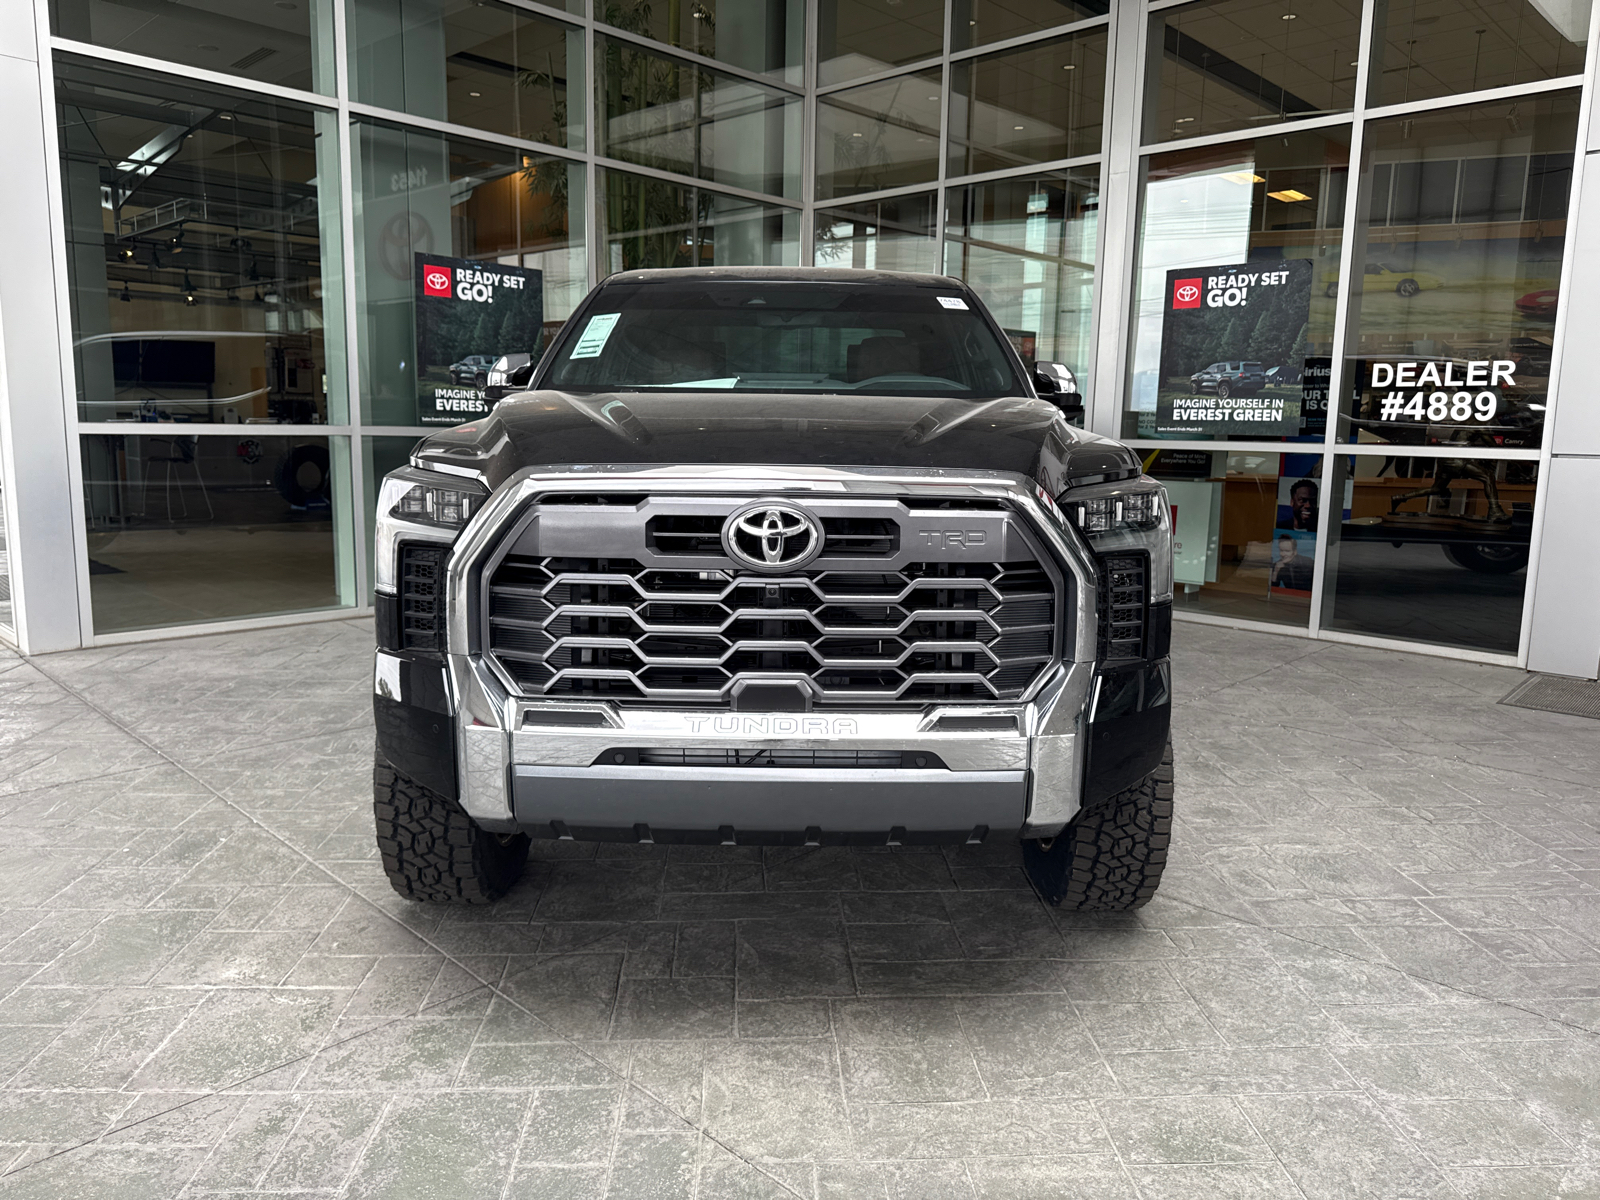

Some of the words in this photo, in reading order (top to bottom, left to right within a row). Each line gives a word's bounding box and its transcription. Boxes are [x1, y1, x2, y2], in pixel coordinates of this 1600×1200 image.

[456, 268, 501, 286] READY
[502, 275, 525, 289] SET
[1207, 273, 1258, 289] READY
[1261, 271, 1290, 286] SET
[456, 282, 493, 304] GO!
[1206, 287, 1248, 308] GO!
[1371, 360, 1517, 388] DEALER
[435, 388, 476, 399] IMAGINE
[1173, 399, 1216, 408] IMAGINE
[1217, 399, 1270, 408] YOURSELF
[1272, 399, 1284, 408] IN
[1172, 409, 1231, 421] EVEREST
[1233, 409, 1283, 422] GREEN
[1380, 391, 1497, 422] #4889
[1504, 438, 1524, 446] Camry
[919, 529, 987, 550] TRD
[684, 716, 858, 735] TUNDRA
